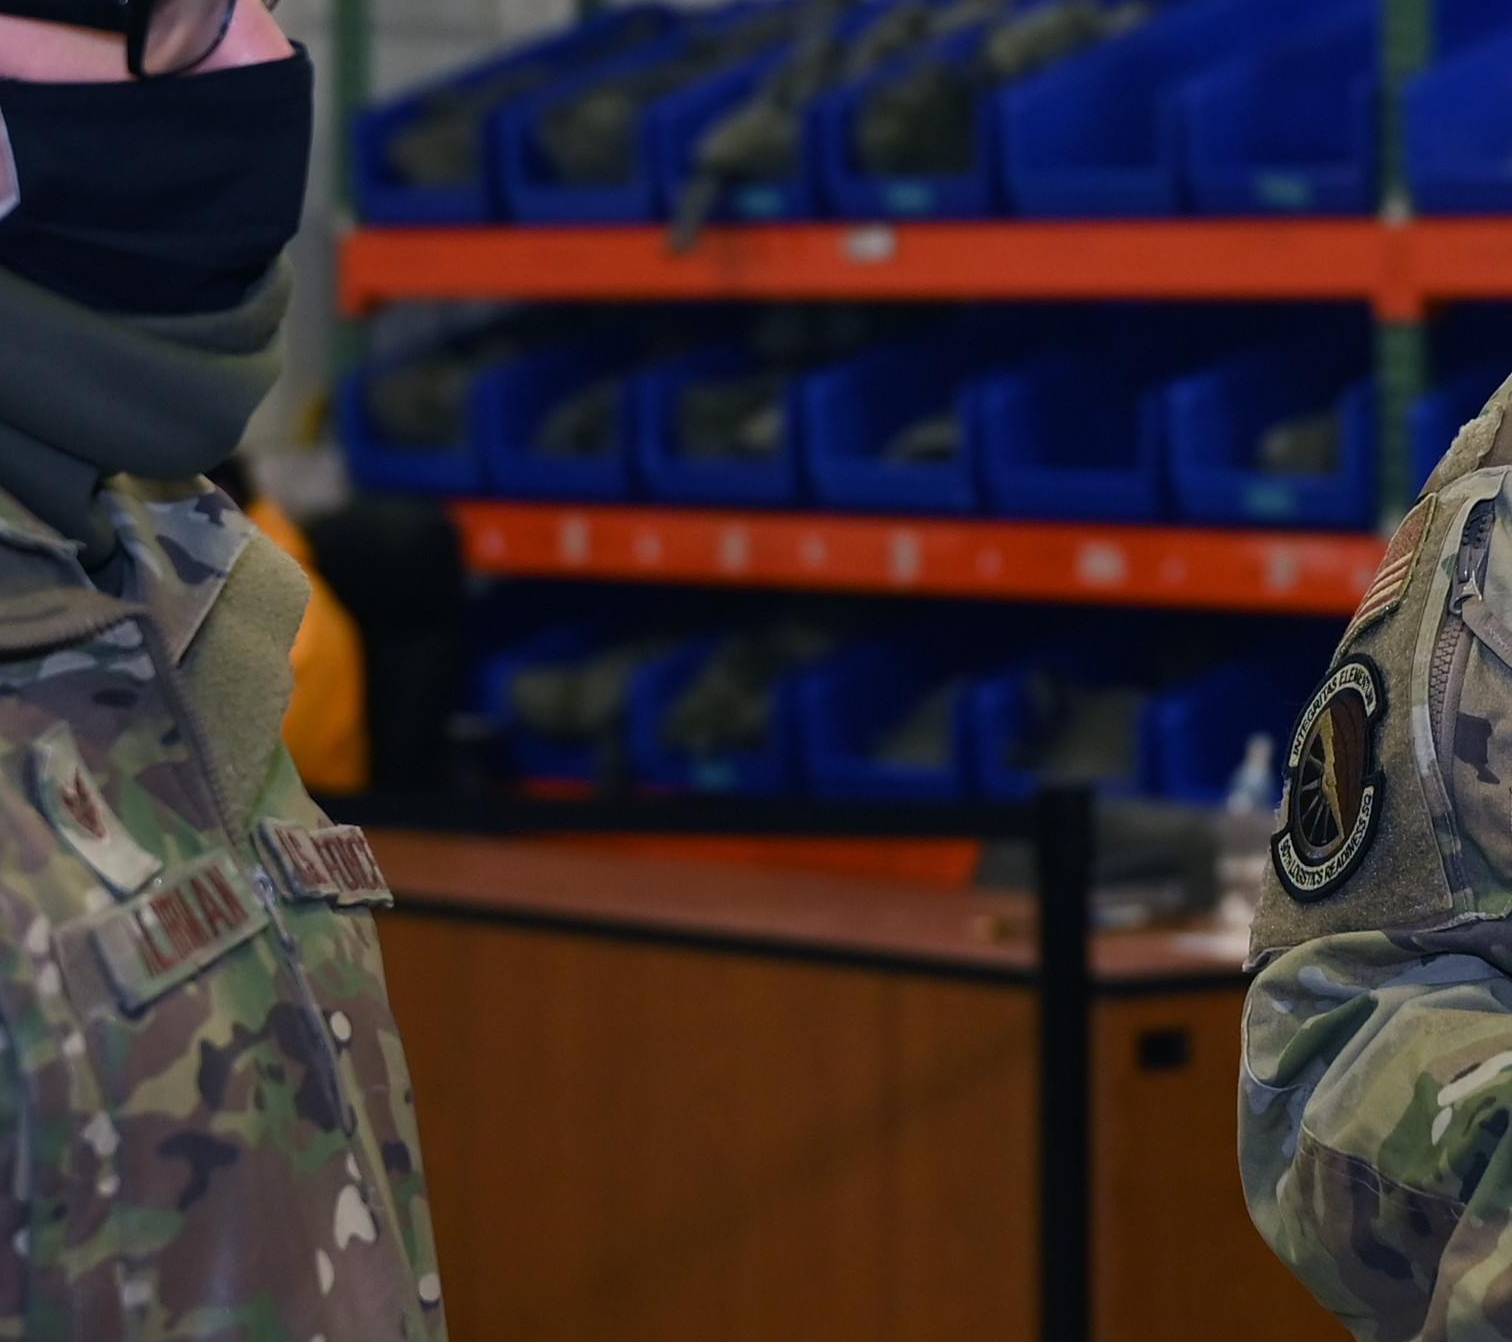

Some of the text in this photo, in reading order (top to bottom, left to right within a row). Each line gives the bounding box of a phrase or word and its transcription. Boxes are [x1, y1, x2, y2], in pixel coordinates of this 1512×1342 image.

[1292, 676, 1338, 756] INTEGRITAS
[1324, 816, 1367, 881] READINESS
[1362, 794, 1373, 818] SQ
